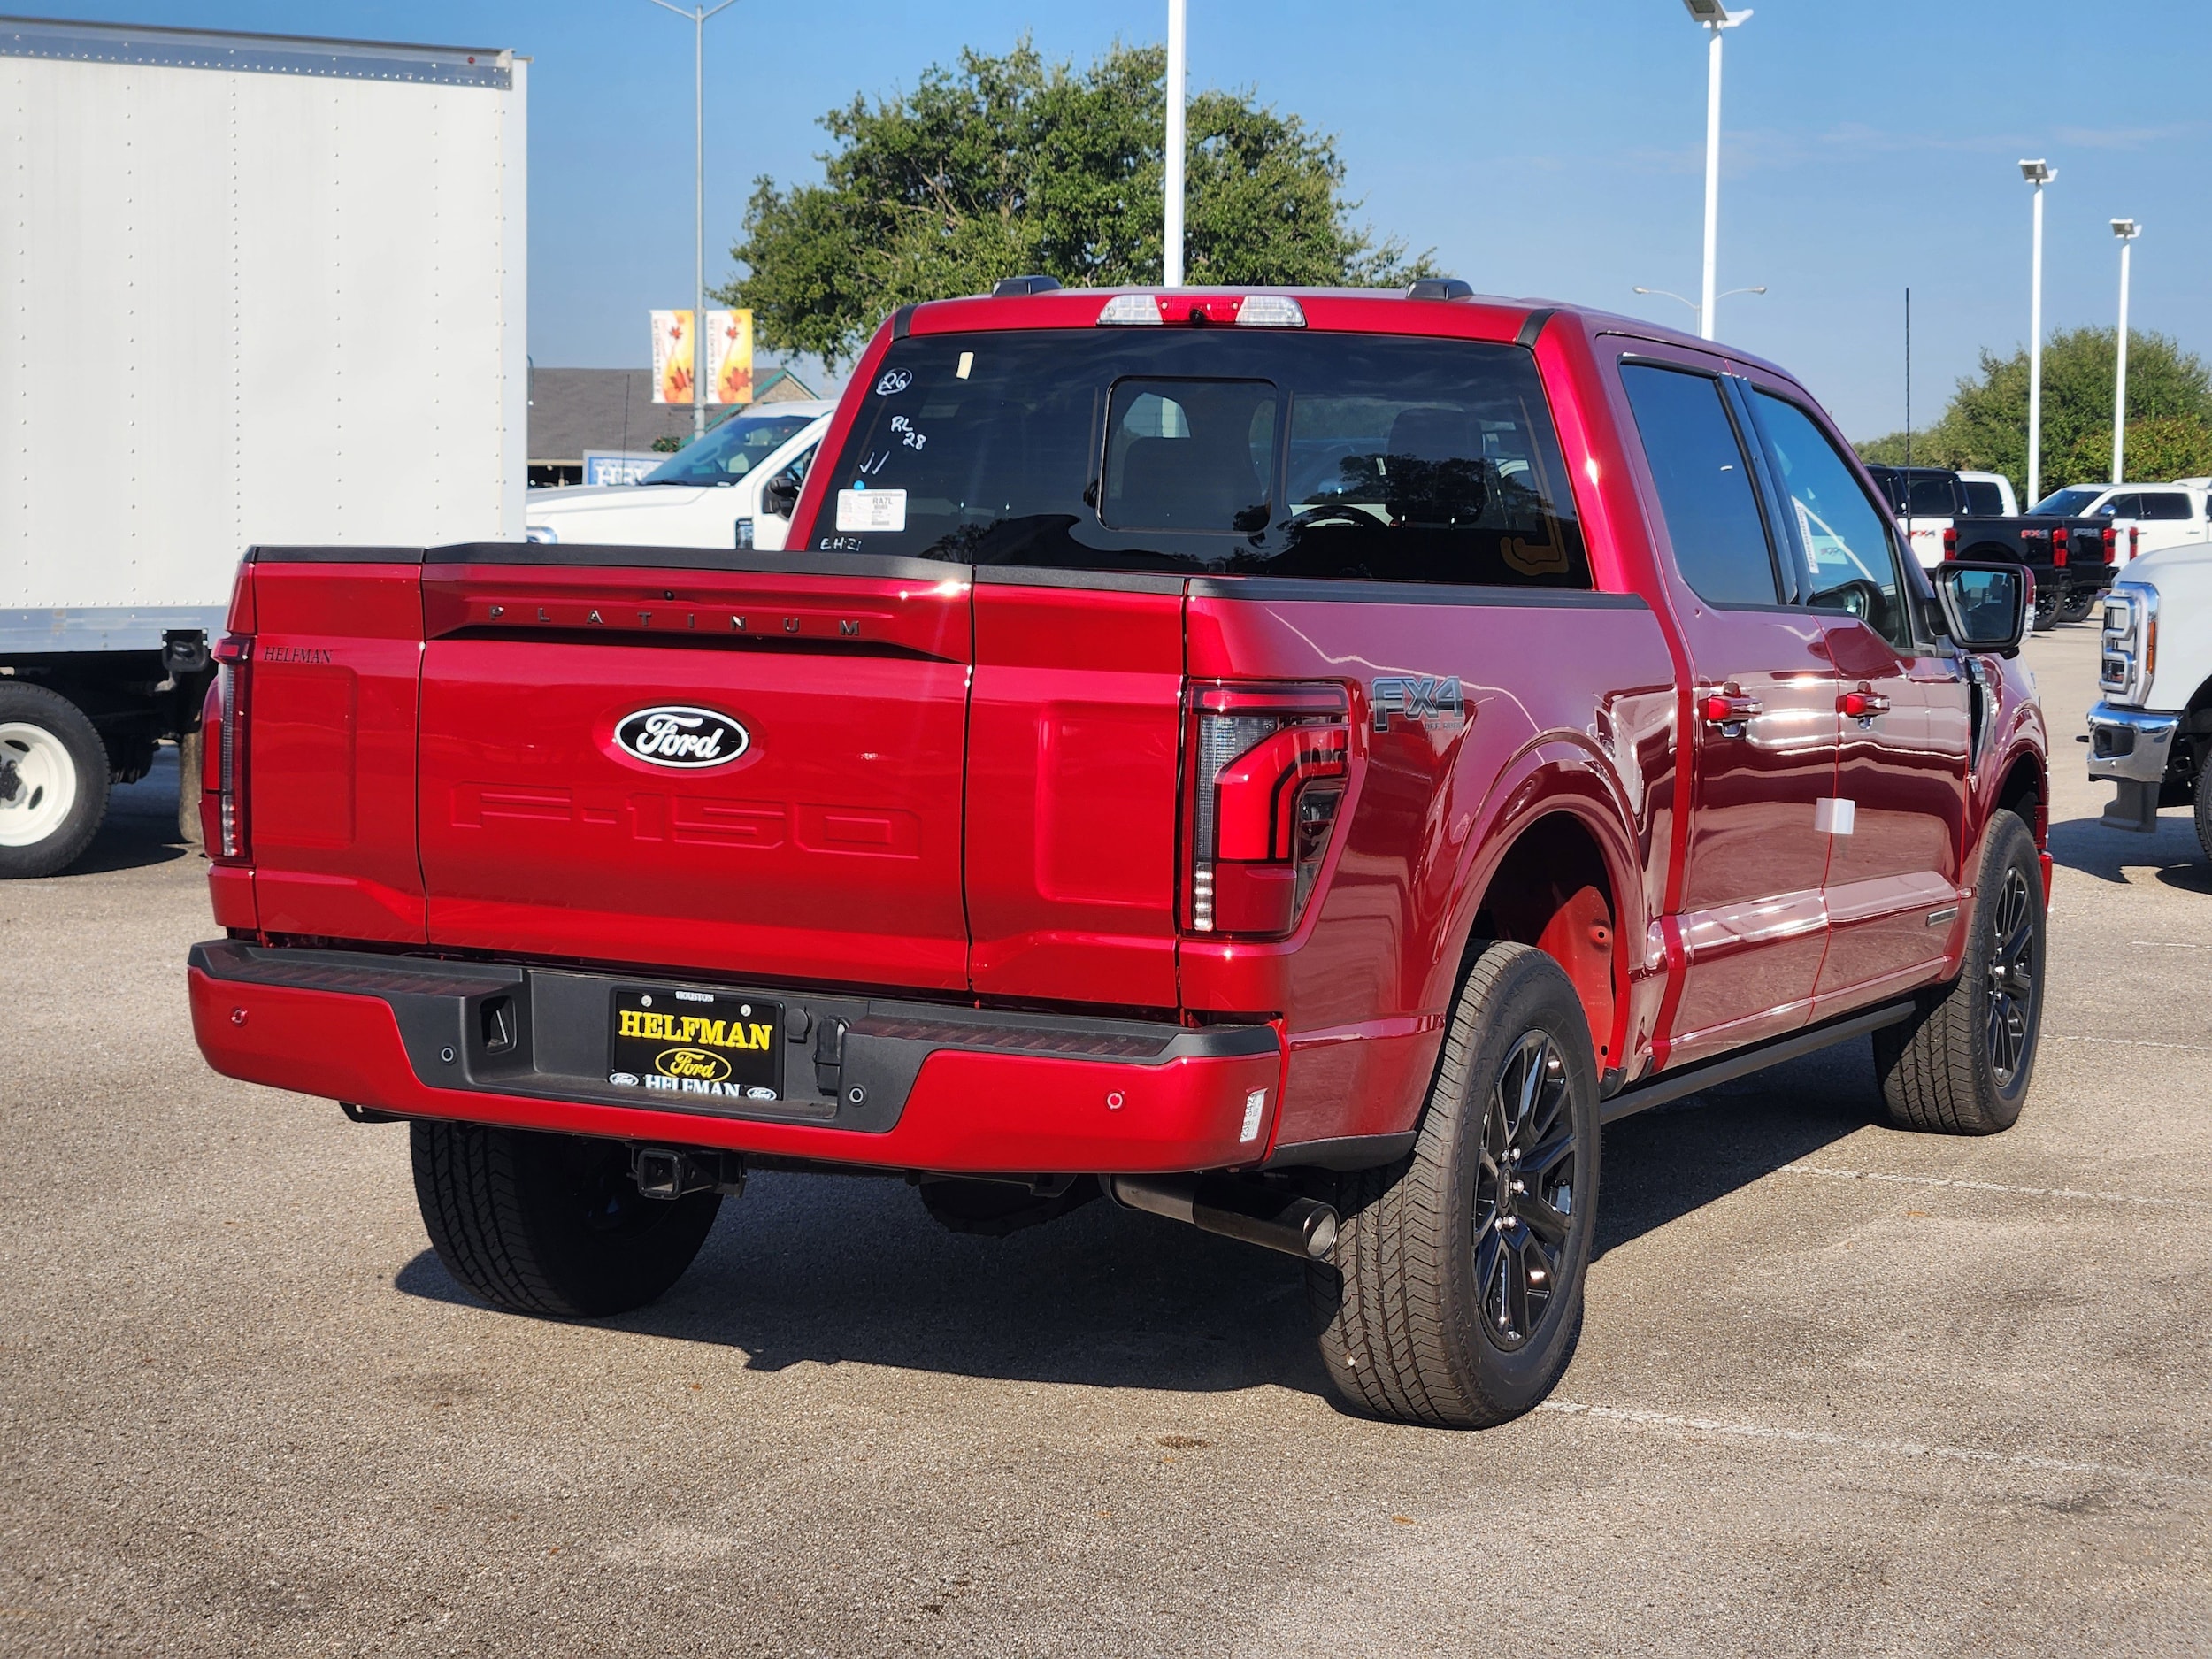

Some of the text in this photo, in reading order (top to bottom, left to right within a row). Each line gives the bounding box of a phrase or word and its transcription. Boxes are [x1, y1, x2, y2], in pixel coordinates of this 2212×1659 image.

[488, 605, 861, 637] PLATINUM
[263, 646, 334, 664] HELFMAN
[1371, 675, 1465, 733] FX4
[635, 713, 725, 758] Ford
[450, 780, 923, 859] F-150
[675, 990, 715, 1002] HOUSTON
[618, 1010, 773, 1051] HELFMAN
[669, 1051, 717, 1078] Ford
[644, 1074, 741, 1097] HELFMAN
